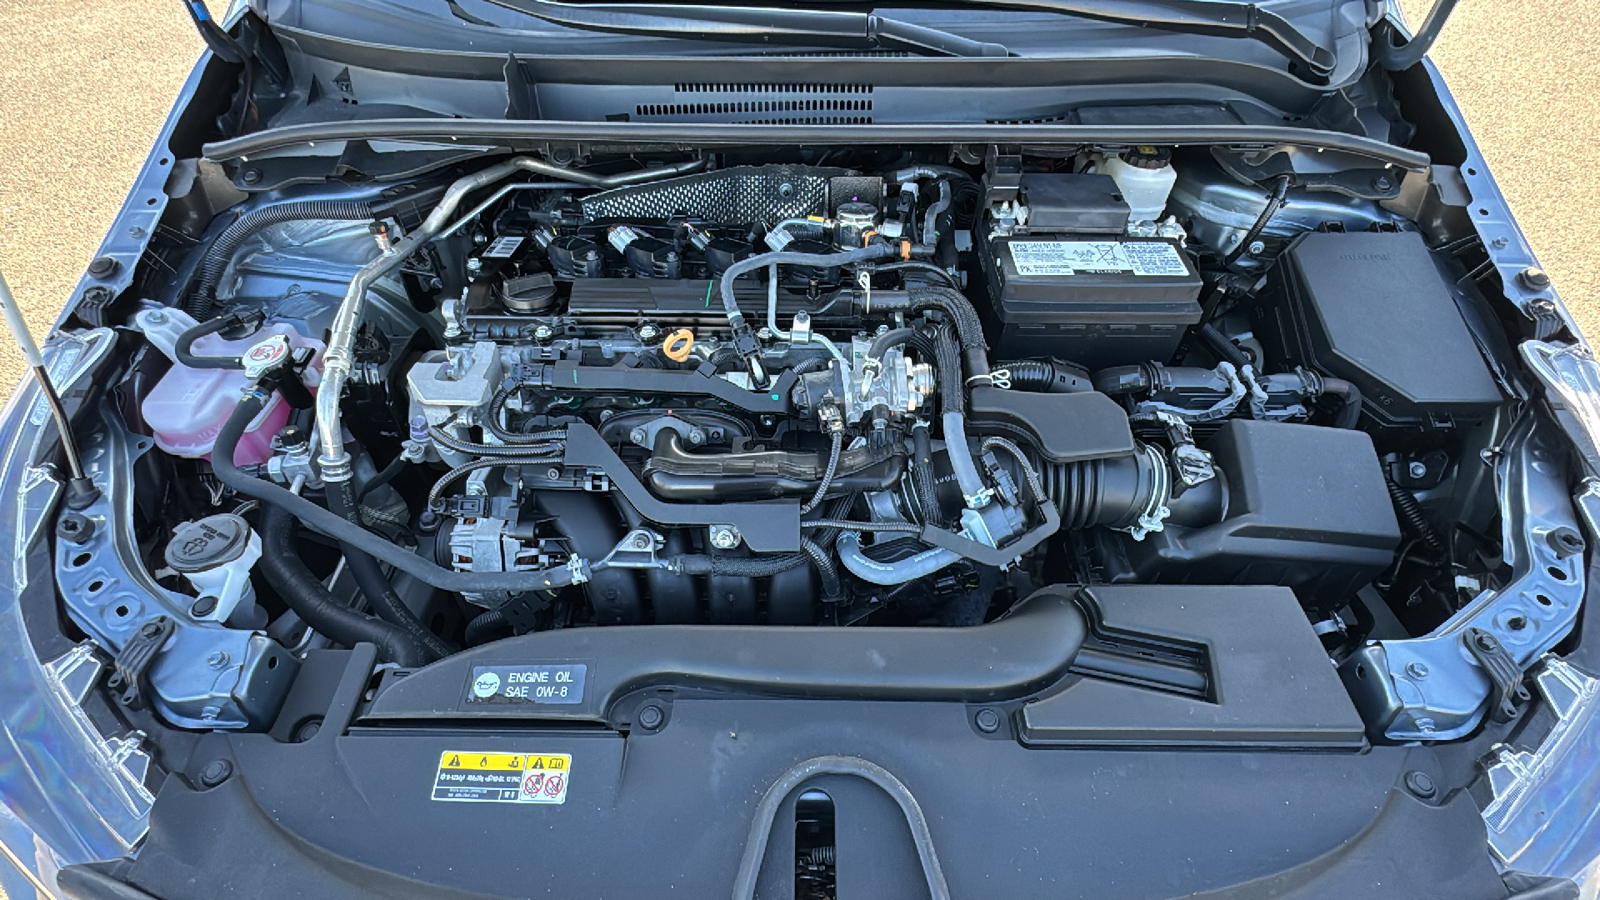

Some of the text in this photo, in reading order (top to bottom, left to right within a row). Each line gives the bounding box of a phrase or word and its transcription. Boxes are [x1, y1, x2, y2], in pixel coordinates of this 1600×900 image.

[198, 424, 222, 443] MAX
[508, 671, 573, 683] ENGINE OIL
[505, 686, 568, 697] SAE 0W-8
